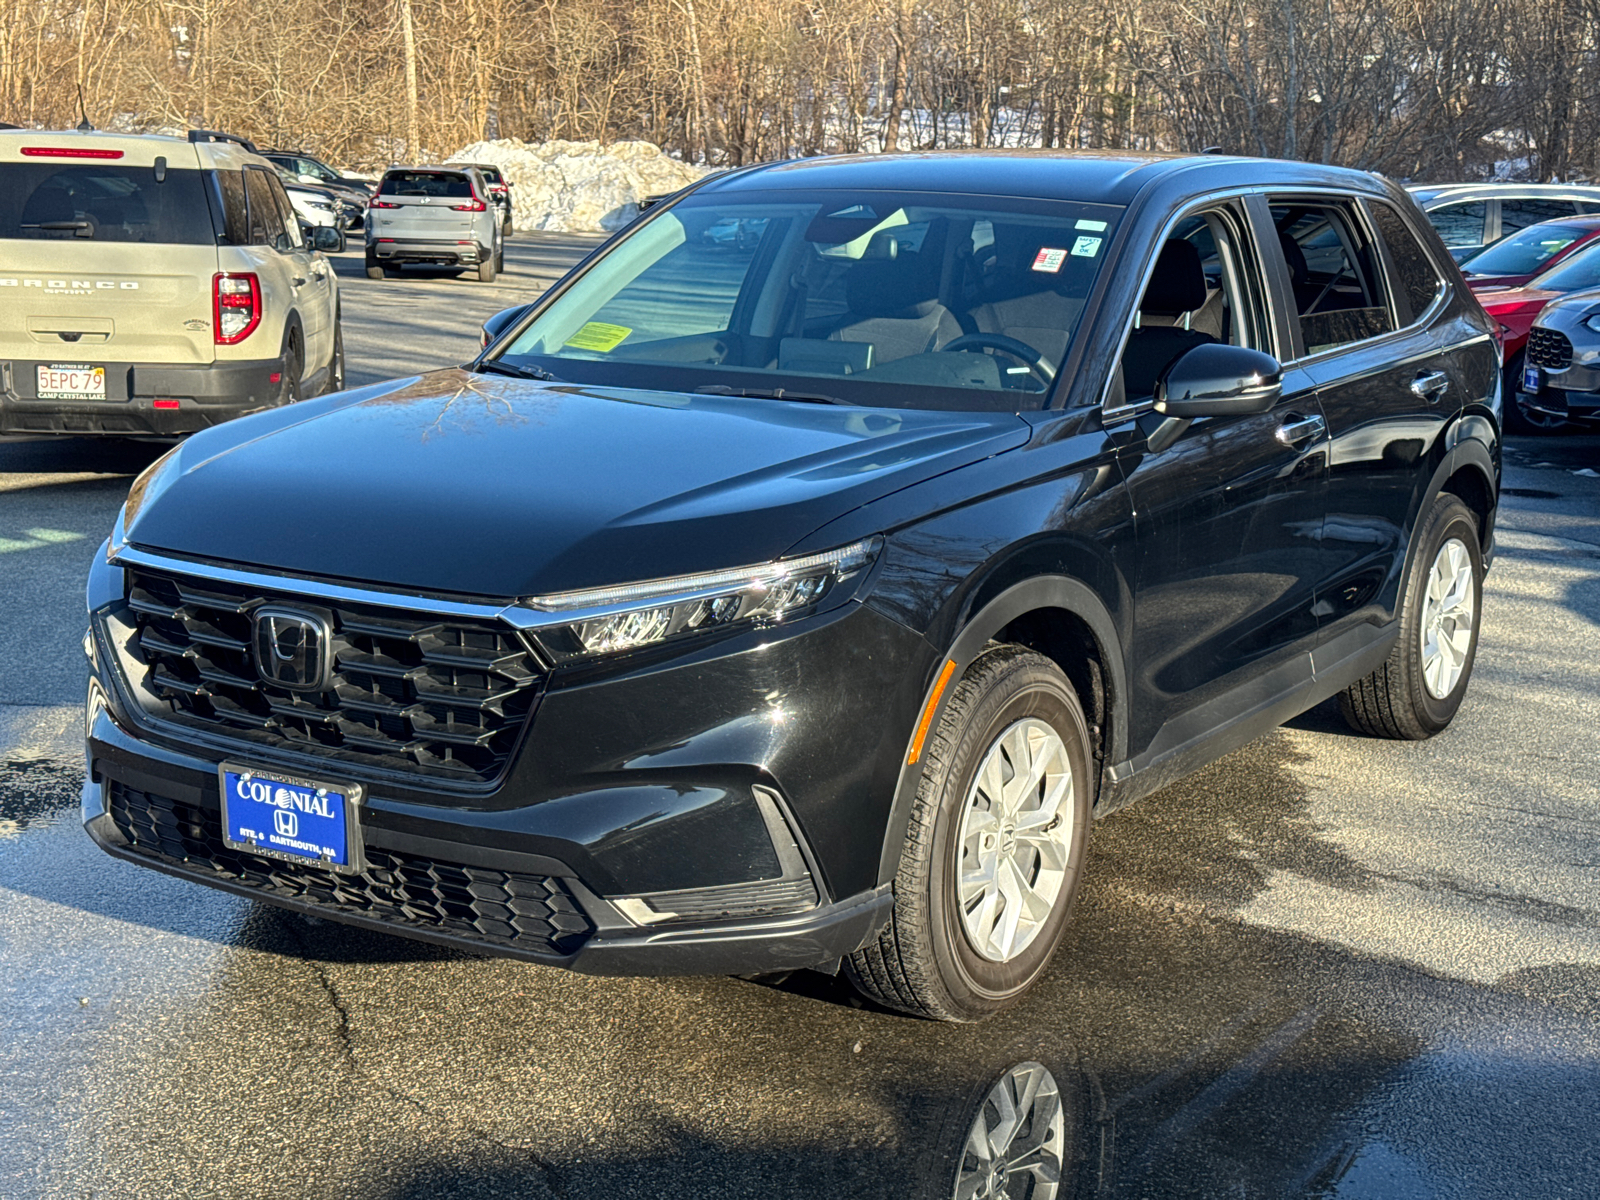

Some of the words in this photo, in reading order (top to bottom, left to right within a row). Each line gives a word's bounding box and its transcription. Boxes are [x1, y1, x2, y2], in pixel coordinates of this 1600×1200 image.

[0, 279, 139, 290] BRONCO
[40, 371, 79, 390] 5EPC
[83, 373, 102, 390] 79
[58, 392, 88, 400] CRYSTAL
[236, 779, 335, 819] COLONIAL
[239, 827, 258, 839] RTE.
[258, 832, 265, 841] 6
[269, 834, 323, 854] DARTMOUTH,
[323, 846, 337, 857] MA
